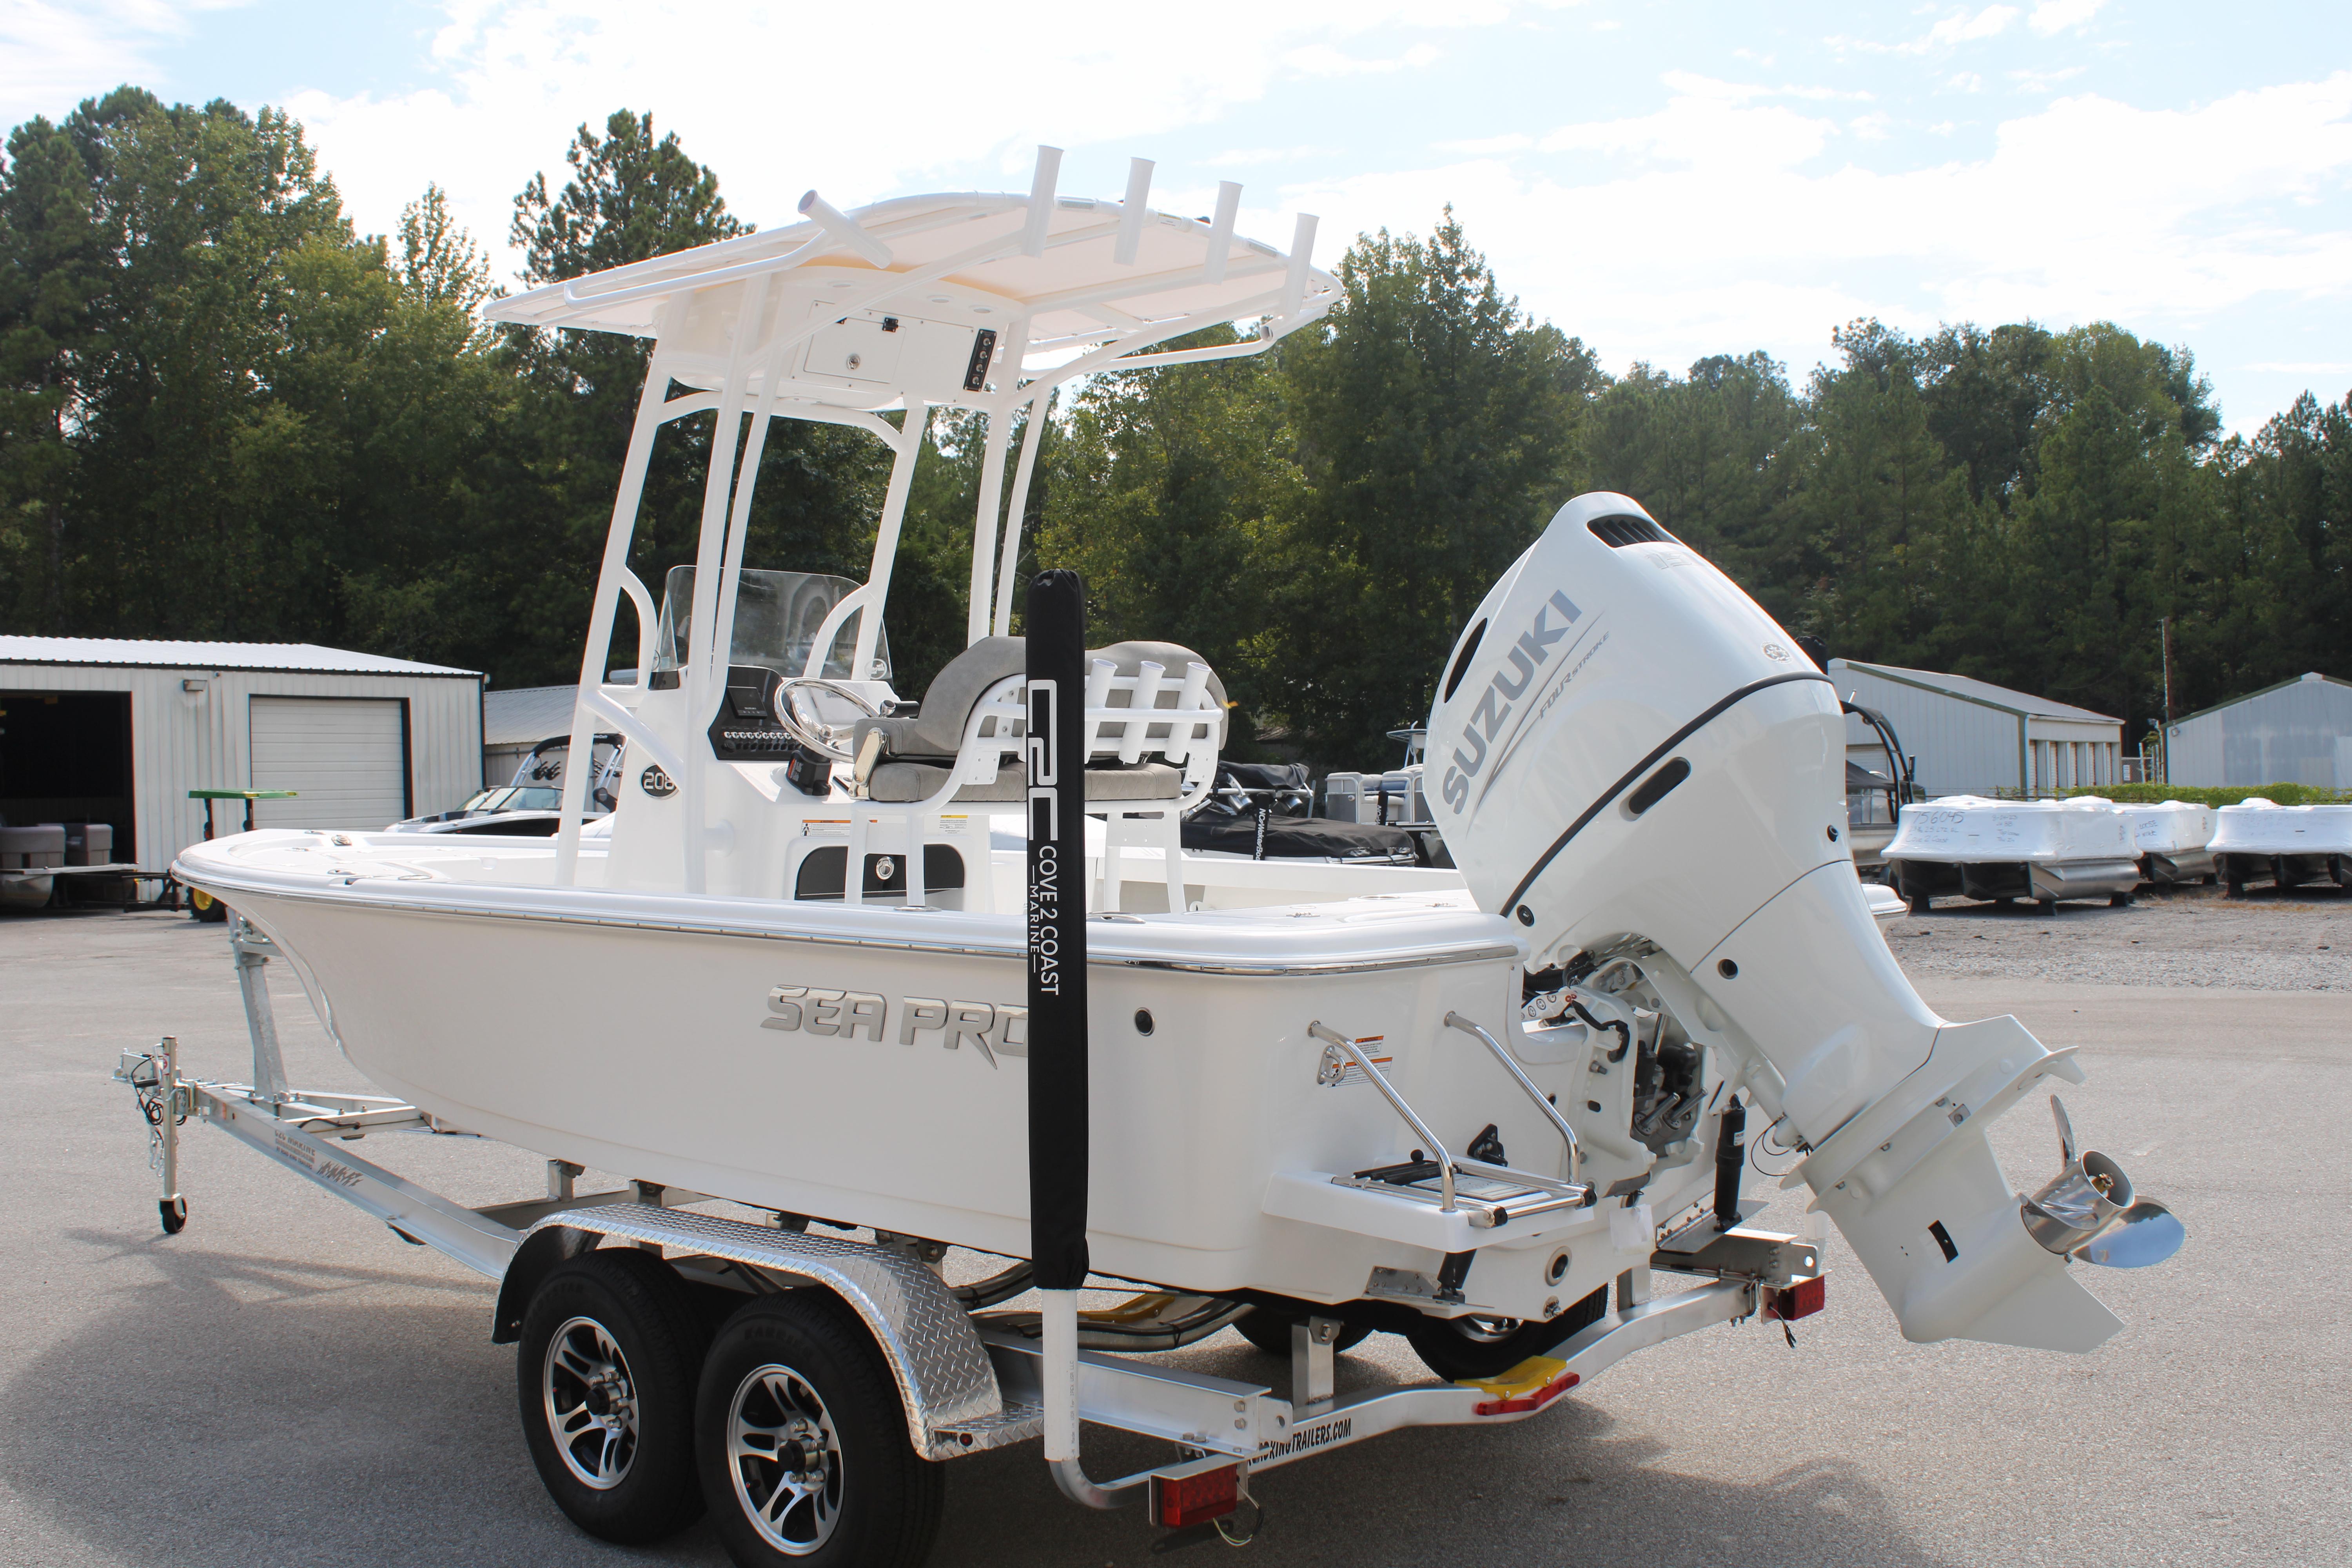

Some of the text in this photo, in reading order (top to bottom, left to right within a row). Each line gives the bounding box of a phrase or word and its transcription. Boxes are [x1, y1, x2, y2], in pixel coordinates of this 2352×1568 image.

[1443, 590, 1582, 815] SUZUKI
[644, 771, 674, 790] 208
[1028, 680, 1058, 840] C2C
[1913, 811, 1965, 824] 756045
[1030, 886, 1039, 952] MARINE
[1039, 846, 1058, 995] COVE 2 COAST
[760, 984, 1029, 1070] SEA PRO
